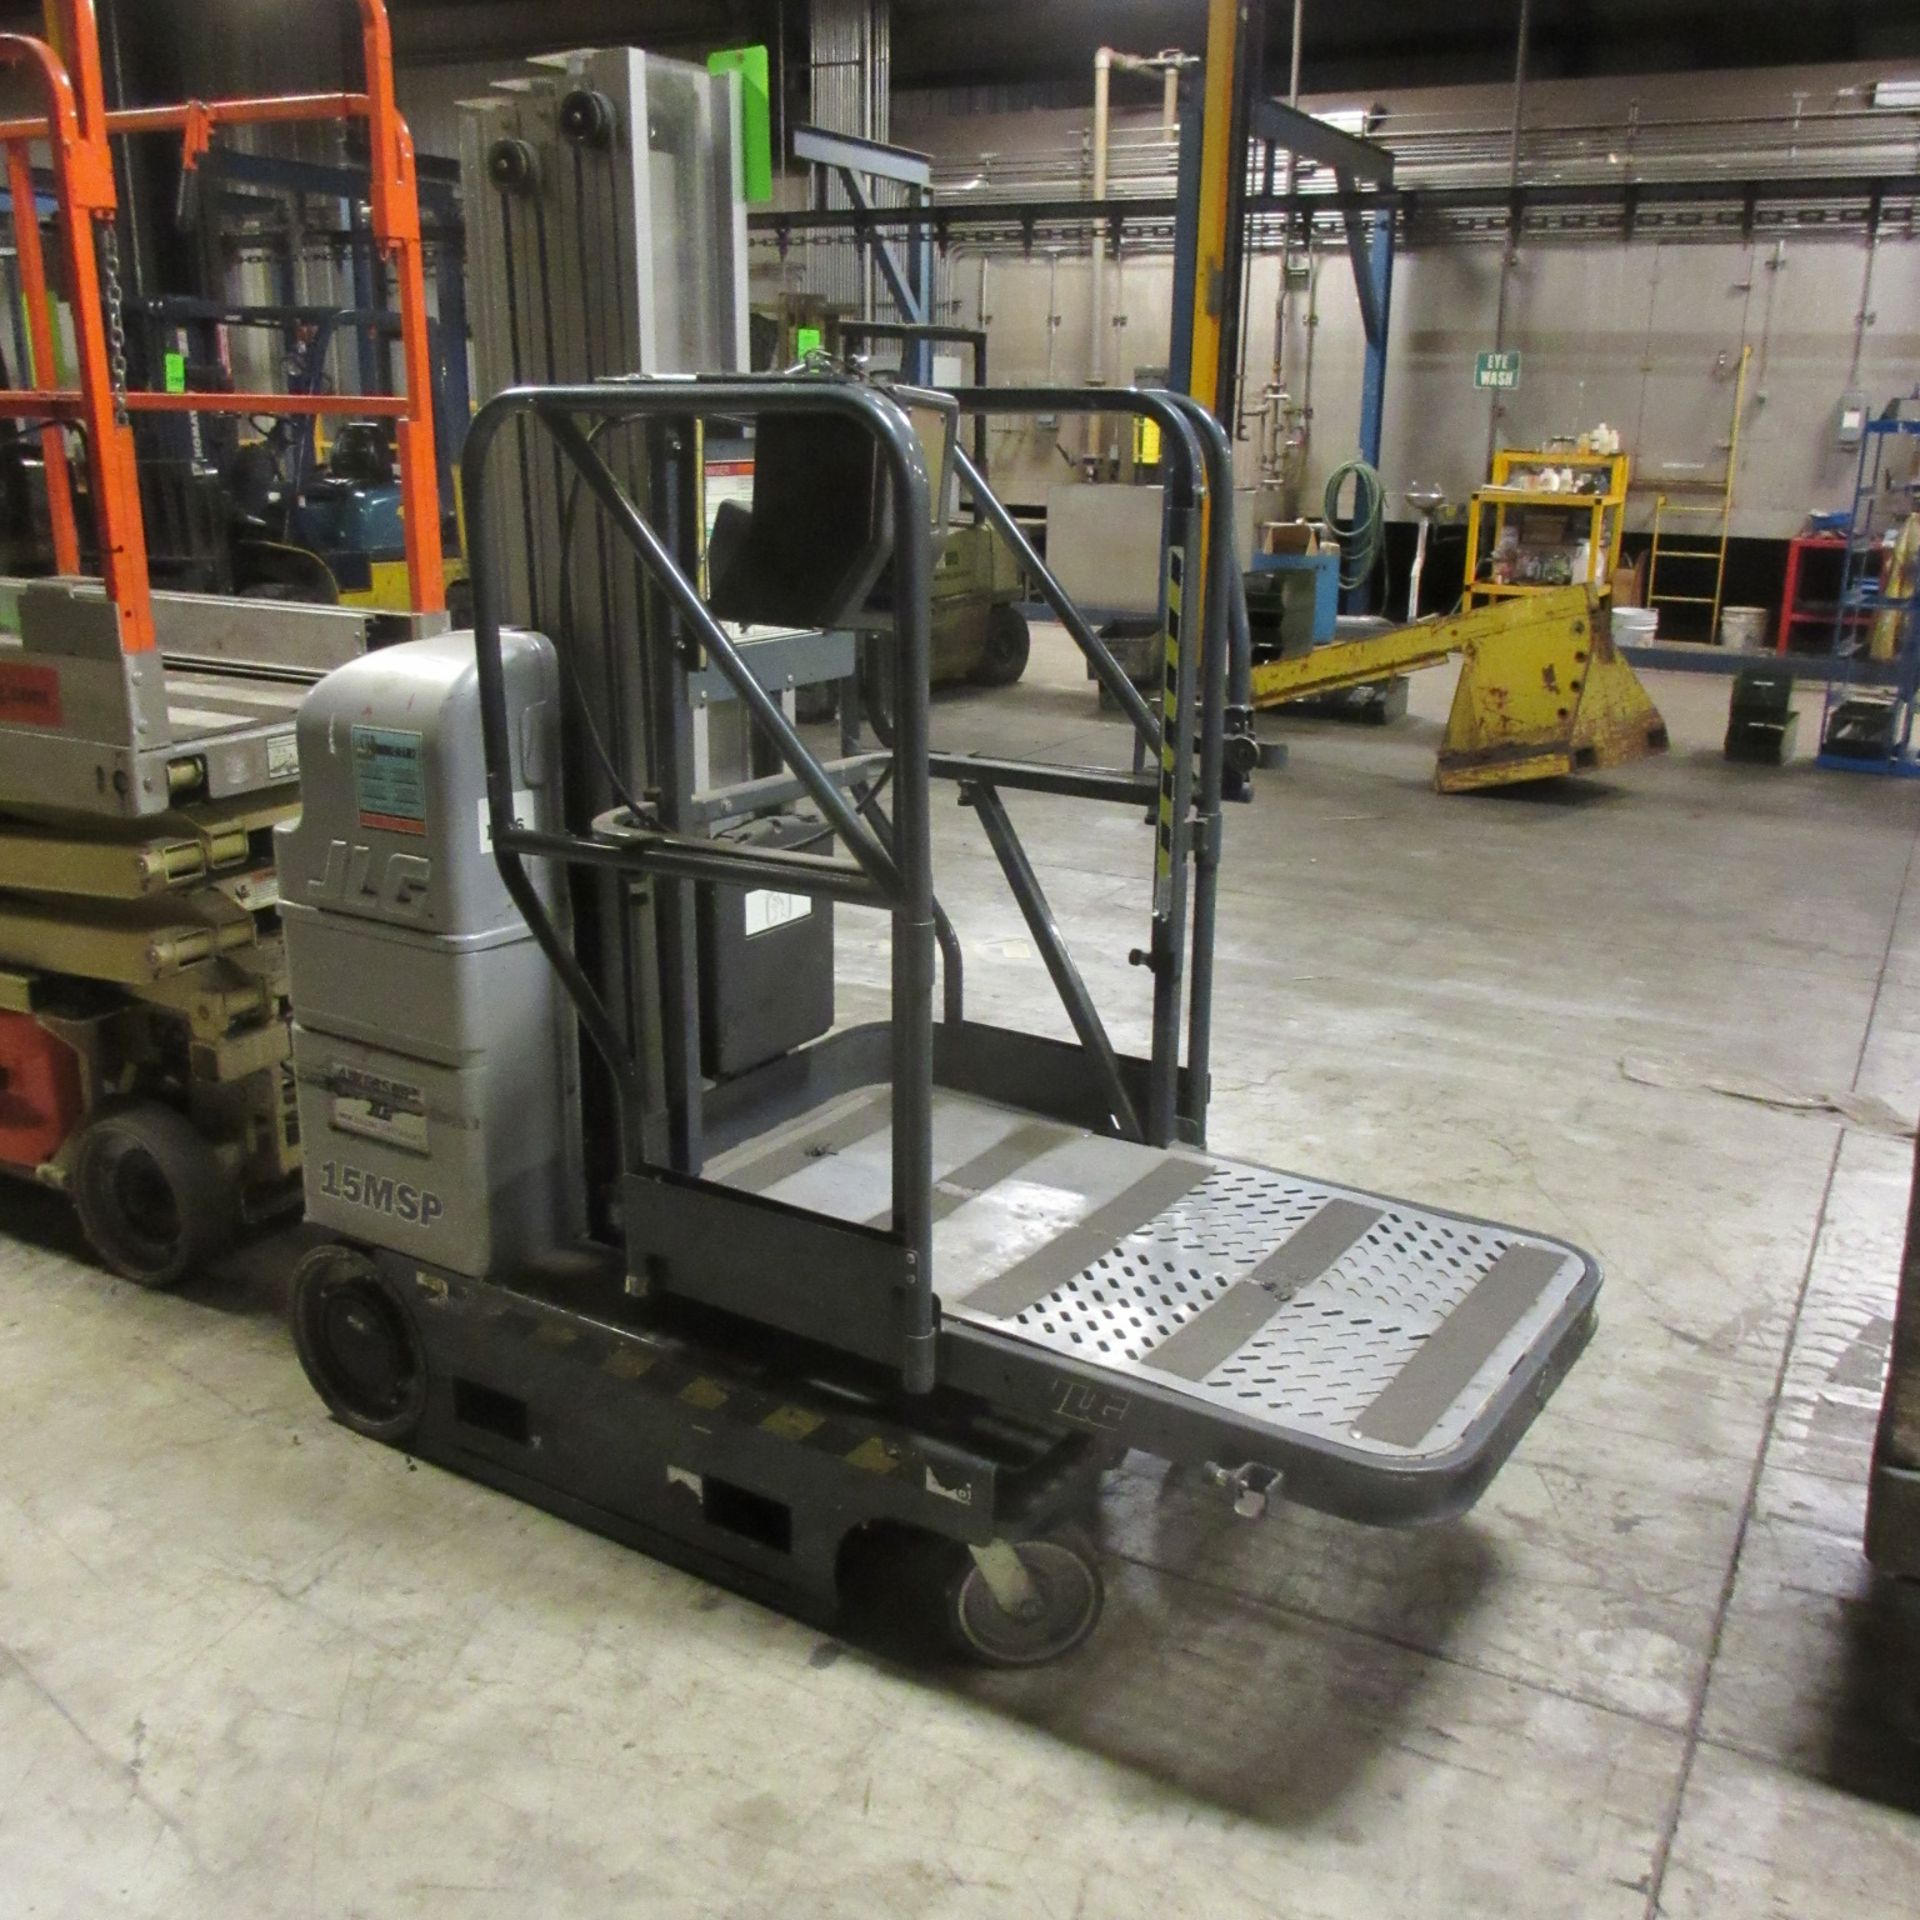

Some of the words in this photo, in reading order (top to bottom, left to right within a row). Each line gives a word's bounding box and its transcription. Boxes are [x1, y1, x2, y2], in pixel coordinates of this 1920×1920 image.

[1480, 370, 1514, 386] WASH
[1487, 354, 1508, 369] EYE
[307, 839, 432, 918] JLG
[320, 1160, 444, 1228] 15MSP
